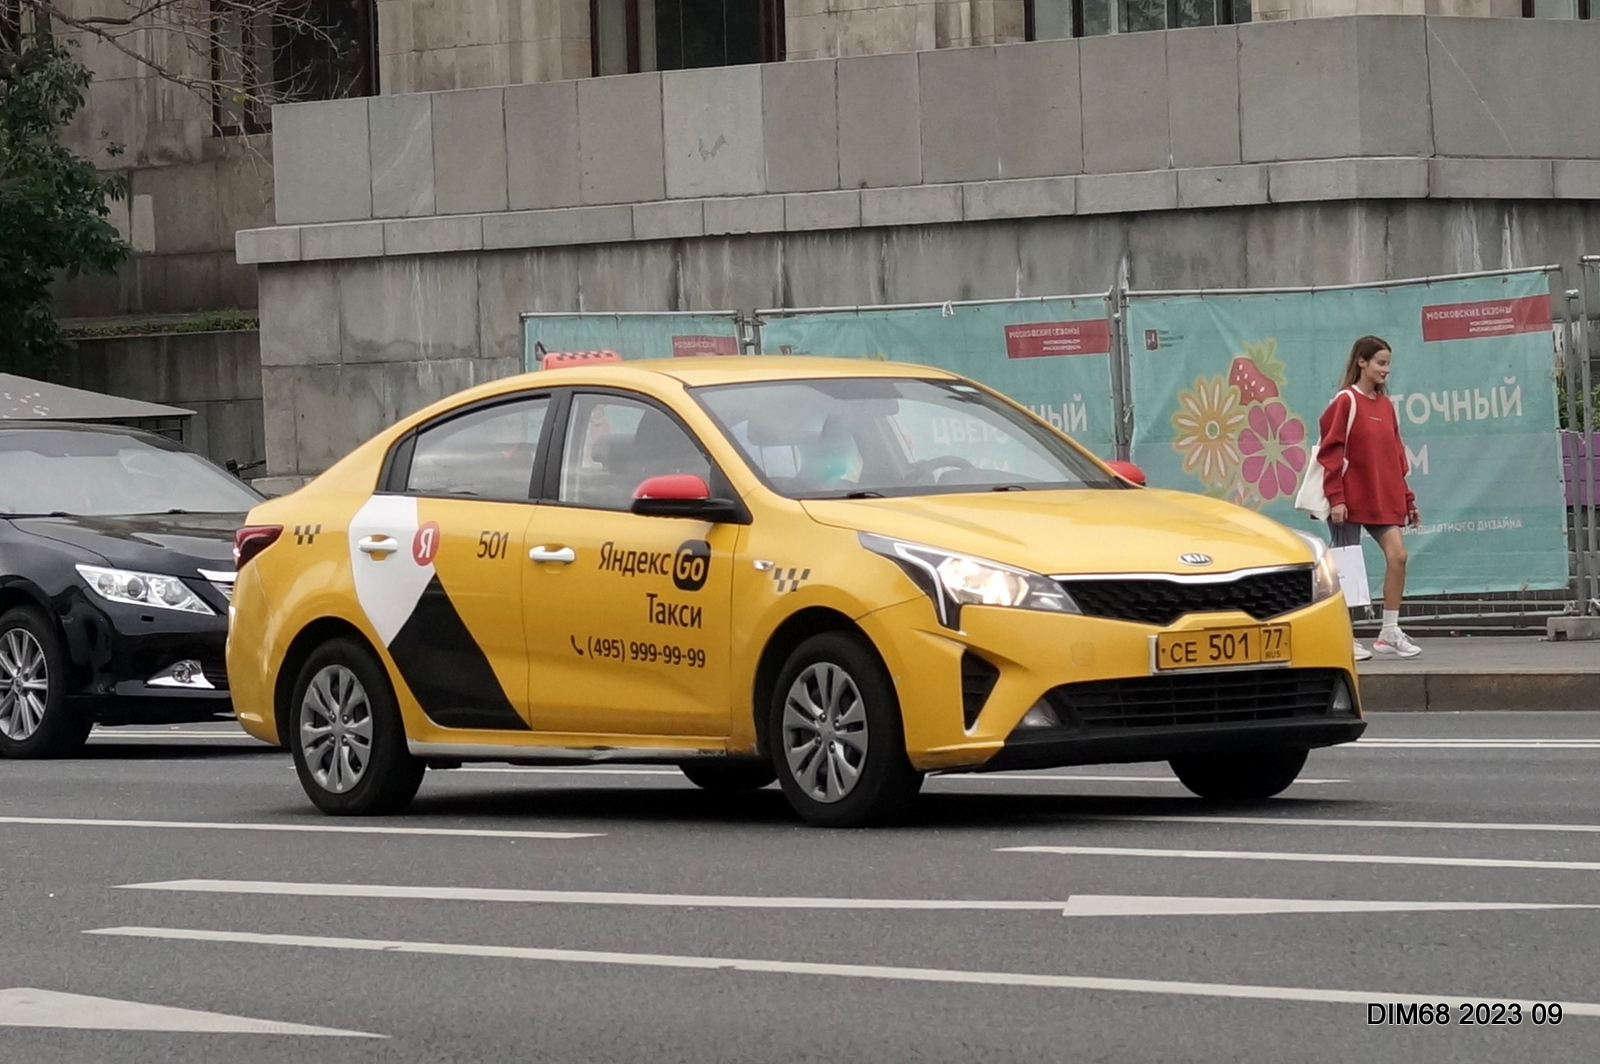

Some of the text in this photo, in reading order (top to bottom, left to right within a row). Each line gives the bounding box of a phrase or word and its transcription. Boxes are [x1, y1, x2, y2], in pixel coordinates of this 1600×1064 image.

[1390, 375, 1522, 425] ТОЧНЫЙ
[417, 527, 435, 559] Я
[476, 530, 509, 559] 501
[598, 541, 705, 582] Яндекс Go
[1180, 553, 1212, 564] KIA
[646, 592, 702, 629] Такси
[588, 636, 706, 668] (495) 999-99-99
[1209, 632, 1249, 661] 501
[1262, 628, 1283, 650] 77
[1265, 651, 1281, 659] RUS
